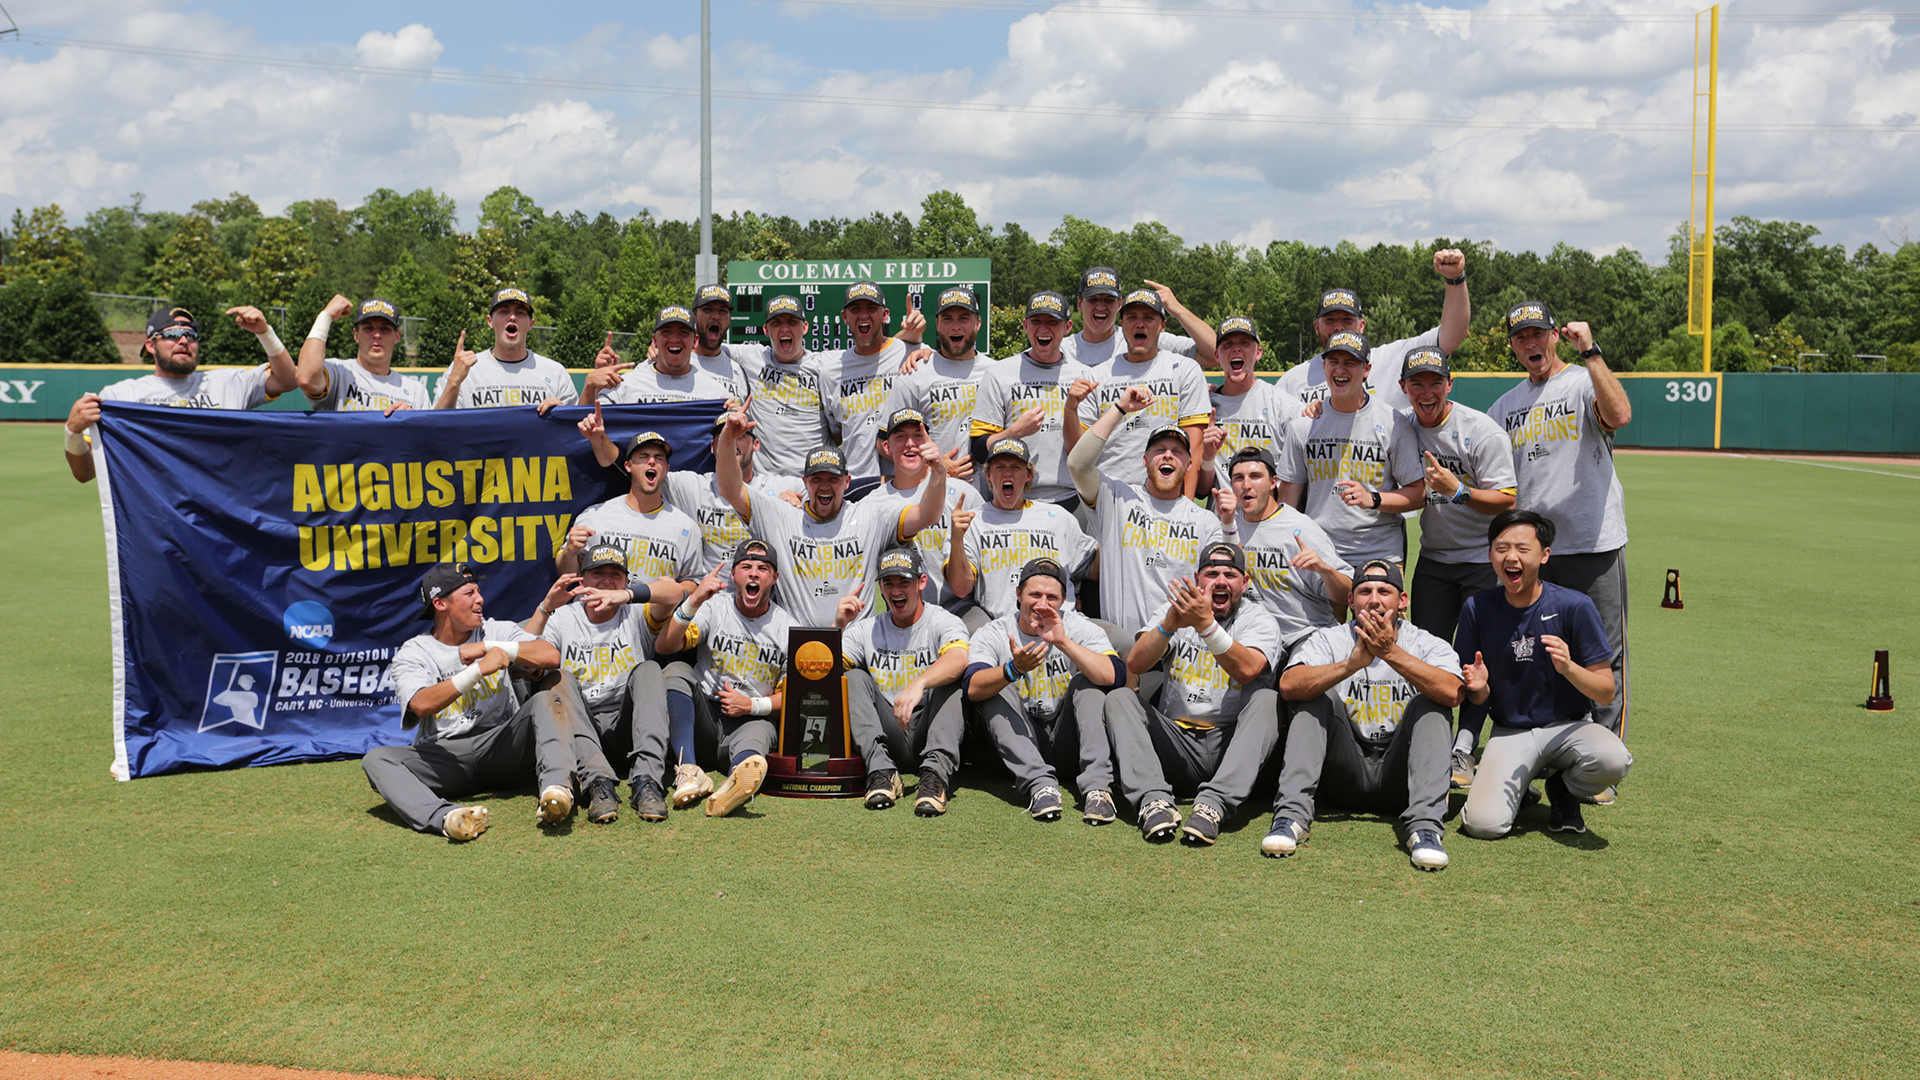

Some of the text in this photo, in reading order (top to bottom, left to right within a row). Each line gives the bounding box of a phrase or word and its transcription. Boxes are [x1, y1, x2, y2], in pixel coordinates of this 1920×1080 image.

[758, 262, 958, 280] COLEMAN FIELD
[736, 285, 763, 295] AT BAT
[800, 285, 821, 295] BALL
[908, 284, 926, 294] OUT
[805, 295, 815, 311] 0
[912, 294, 922, 310] 0
[745, 326, 757, 334] AU
[841, 377, 893, 398] NAT18N
[930, 384, 979, 403] NAT18
[1011, 385, 1070, 400] NAT18N
[1665, 381, 1712, 402] 330
[841, 391, 891, 420] CHAMPI
[931, 399, 976, 425] CHAMP
[1012, 399, 1065, 423] CHAMPI
[1505, 401, 1575, 432] NAT18NAL
[1508, 414, 1579, 453] HAMPIONS
[1306, 443, 1386, 462] NAT18NAL
[1307, 459, 1385, 487] CHAMPIONS
[292, 456, 573, 512] AUGUSTANA
[697, 509, 742, 527] NAT18
[298, 513, 572, 571] UNIVERSITY
[600, 535, 677, 562] NAT18NAL
[980, 534, 1058, 551] NAT18NAL
[1122, 522, 1199, 564] CHAMPIONS
[627, 553, 675, 579] MPIONS
[290, 624, 333, 639] NCAA
[285, 647, 389, 664] 2018 DIVISION
[277, 662, 397, 697] BASEBA
[274, 700, 305, 712] CARY,
[308, 699, 323, 710] NC
[330, 697, 375, 708] University
[377, 697, 387, 705] of
[809, 784, 842, 792] CHAMPION
